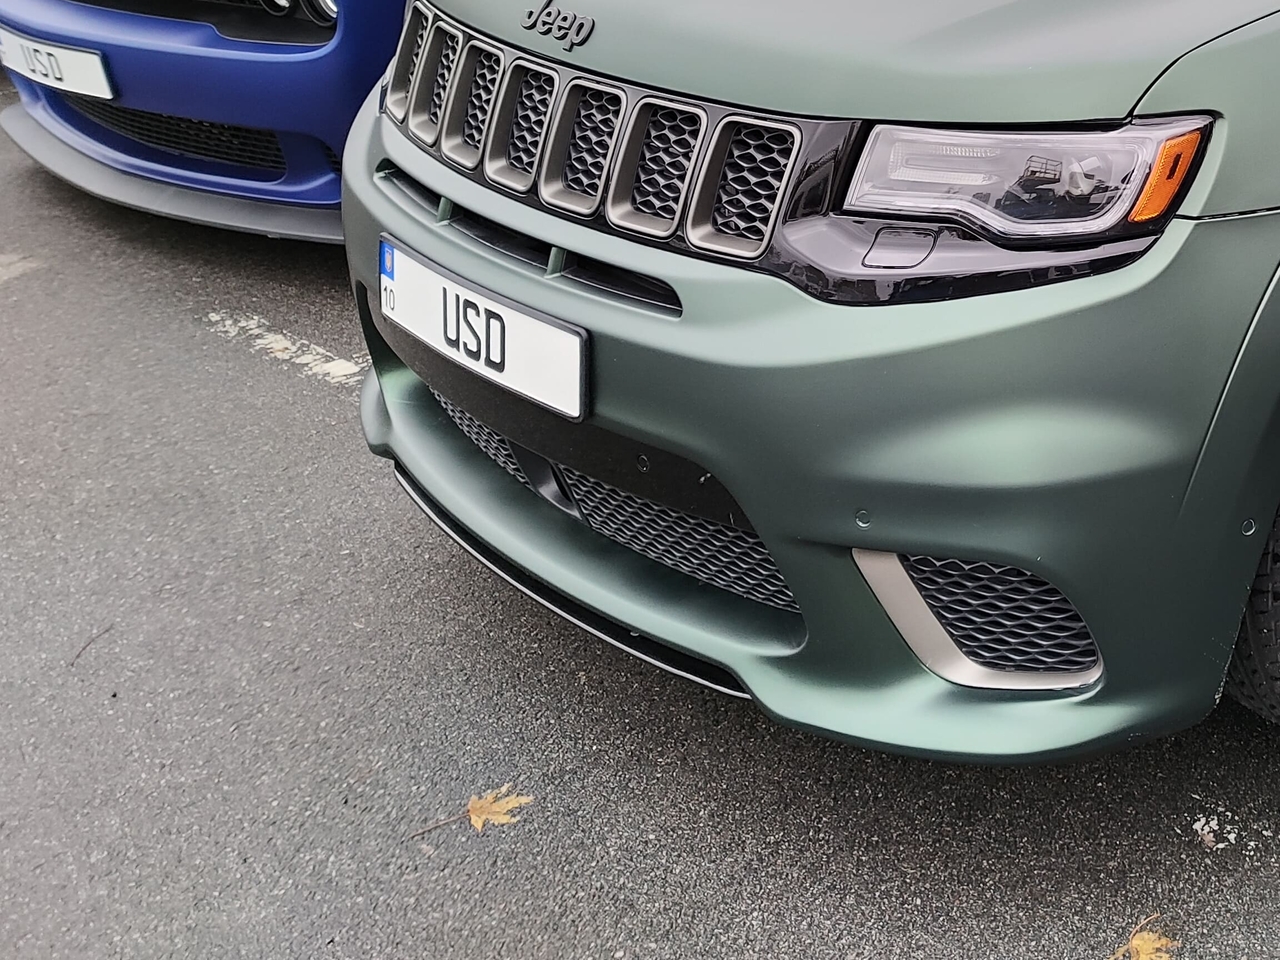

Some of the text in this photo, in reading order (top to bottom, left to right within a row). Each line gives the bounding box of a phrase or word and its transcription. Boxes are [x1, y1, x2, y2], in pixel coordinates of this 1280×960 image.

[20, 44, 64, 82] USD
[383, 285, 396, 311] 10
[442, 286, 506, 373] USD
